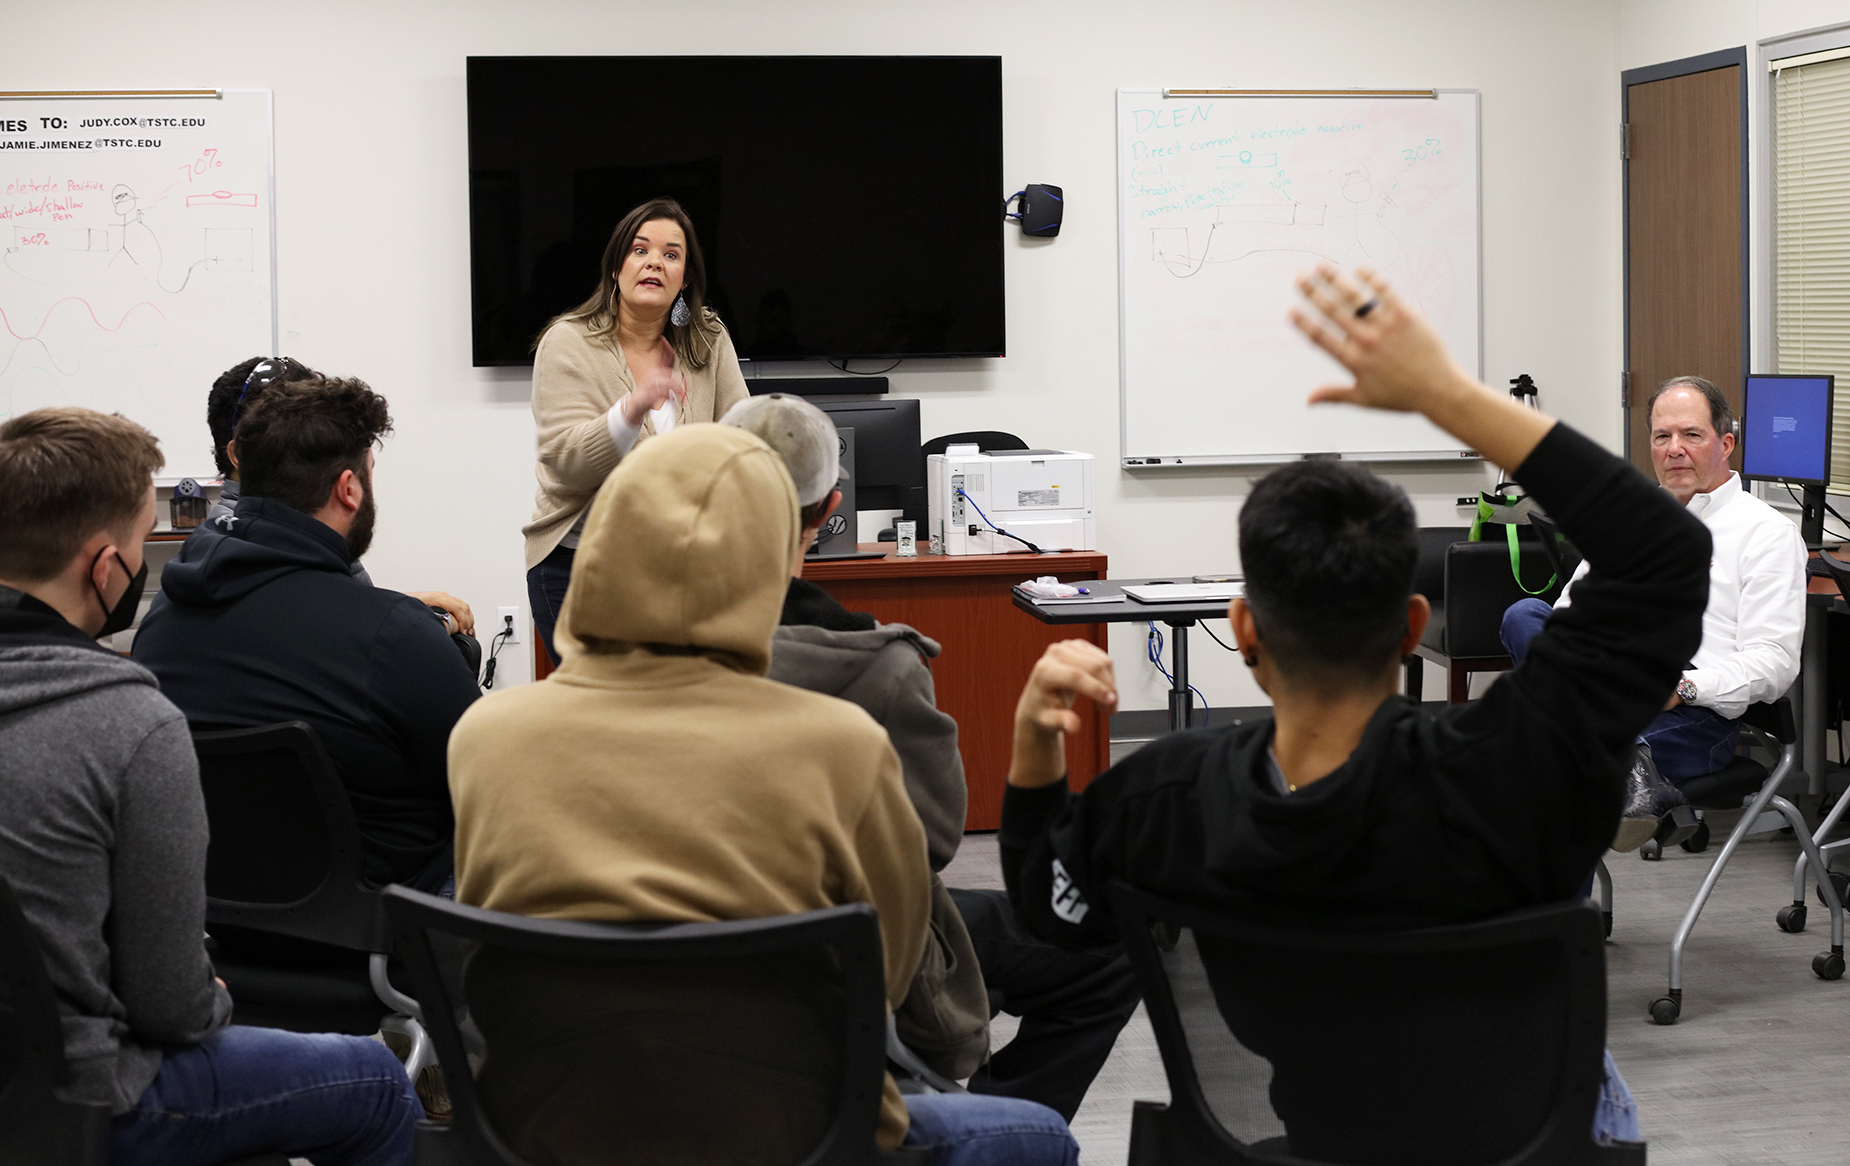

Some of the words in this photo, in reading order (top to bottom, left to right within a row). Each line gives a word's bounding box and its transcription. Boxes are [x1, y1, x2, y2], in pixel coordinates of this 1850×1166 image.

[39, 117, 68, 129] TO:
[79, 116, 206, 129] JUDY.COX@TSTC.EDU
[1131, 103, 1213, 134] DCEN
[0, 137, 162, 150] JAMIE.JIMENEZ@TSTC.EDU
[1131, 140, 1182, 160] Direct
[1189, 130, 1239, 152] current
[1250, 120, 1306, 140] electrode
[1402, 138, 1442, 167] 30%
[179, 148, 222, 182] 70%
[21, 232, 50, 246] 30%
